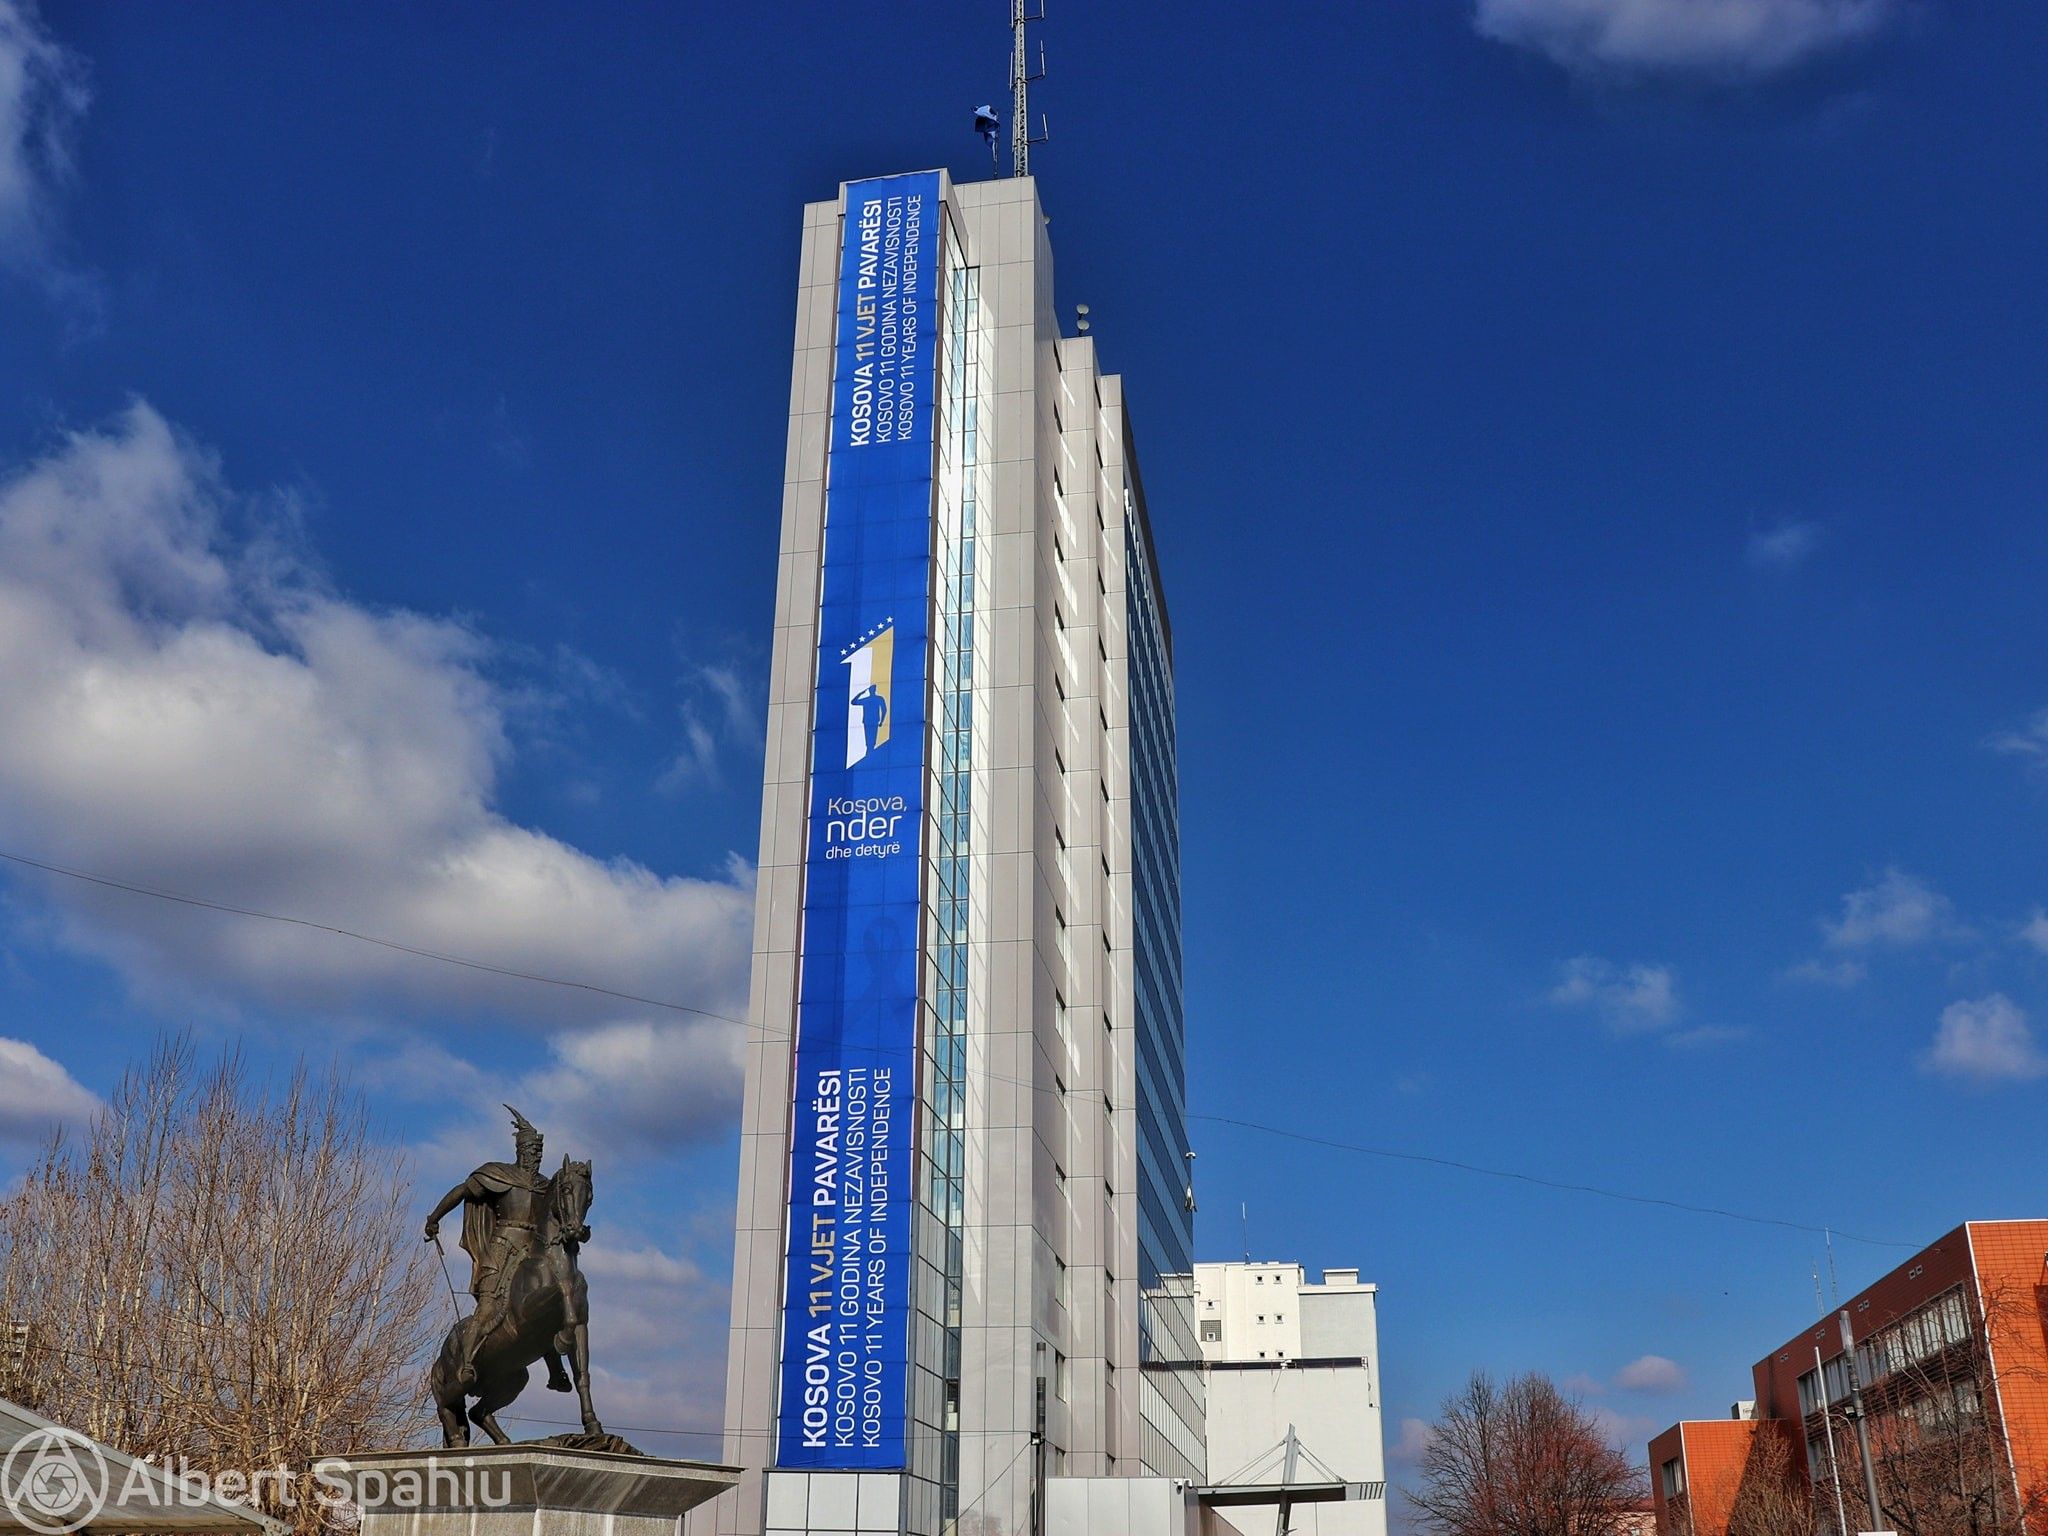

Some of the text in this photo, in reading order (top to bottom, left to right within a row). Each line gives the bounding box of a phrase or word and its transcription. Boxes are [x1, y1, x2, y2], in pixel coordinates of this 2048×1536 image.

[851, 200, 881, 446] KOSOVA 11 VJET PAVARËSI
[876, 197, 901, 442] KOSOVO 11 GODINA NEZAVISNOSTI
[898, 195, 920, 440] KOSOVO 11 YEARS OF INDEPENDENCE
[826, 811, 903, 843] nder
[826, 842, 900, 860] dhe detyrë
[828, 796, 907, 816] Kosova,
[803, 1071, 840, 1446] KOSOVA 11 VJET PAVARËSI
[835, 1069, 866, 1446] KOSOVO 11 GODINA NEZAVISNOSTI
[863, 1068, 891, 1446] KOSOVO 11 YEARS OF INDEPENDENCE
